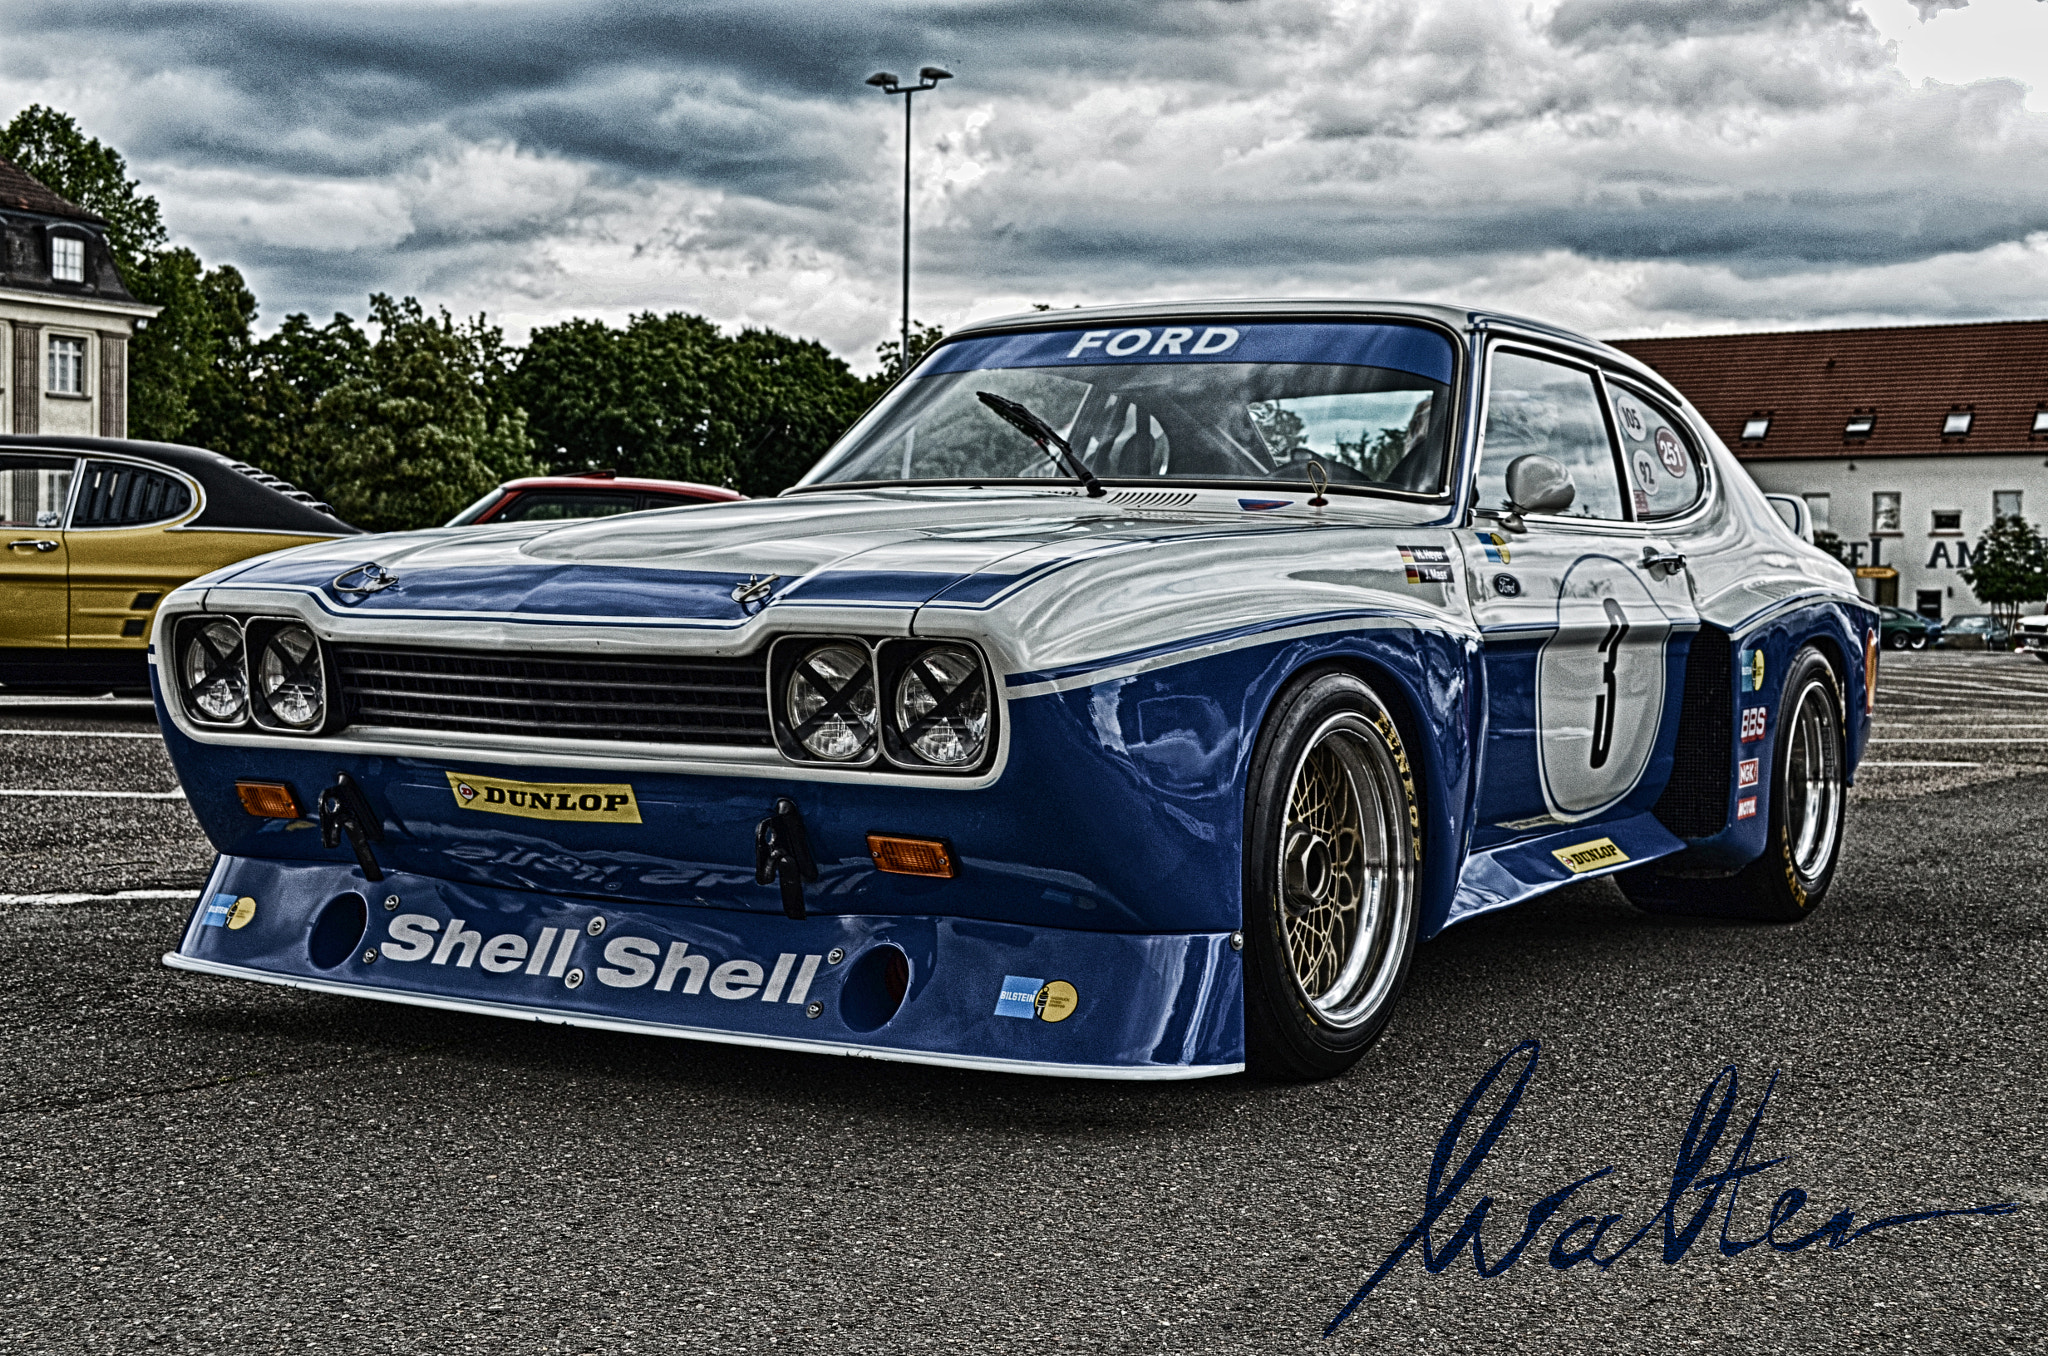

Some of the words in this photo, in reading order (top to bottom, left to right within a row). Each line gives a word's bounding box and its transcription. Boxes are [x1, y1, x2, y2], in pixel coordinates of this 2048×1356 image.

[1066, 327, 1240, 358] FORD
[1621, 407, 1642, 430] 105
[1659, 440, 1684, 467] 251
[1639, 461, 1655, 485] 92
[1498, 576, 1516, 594] Ford
[1590, 598, 1630, 769] 3
[1741, 707, 1767, 741] BBS
[1740, 762, 1755, 784] NGK
[484, 787, 629, 812] DUNLOP
[1570, 844, 1618, 866] DUNLOP
[380, 913, 581, 979] Shell
[597, 936, 823, 1004] Shell
[1000, 990, 1036, 1003] BILSTEIN
